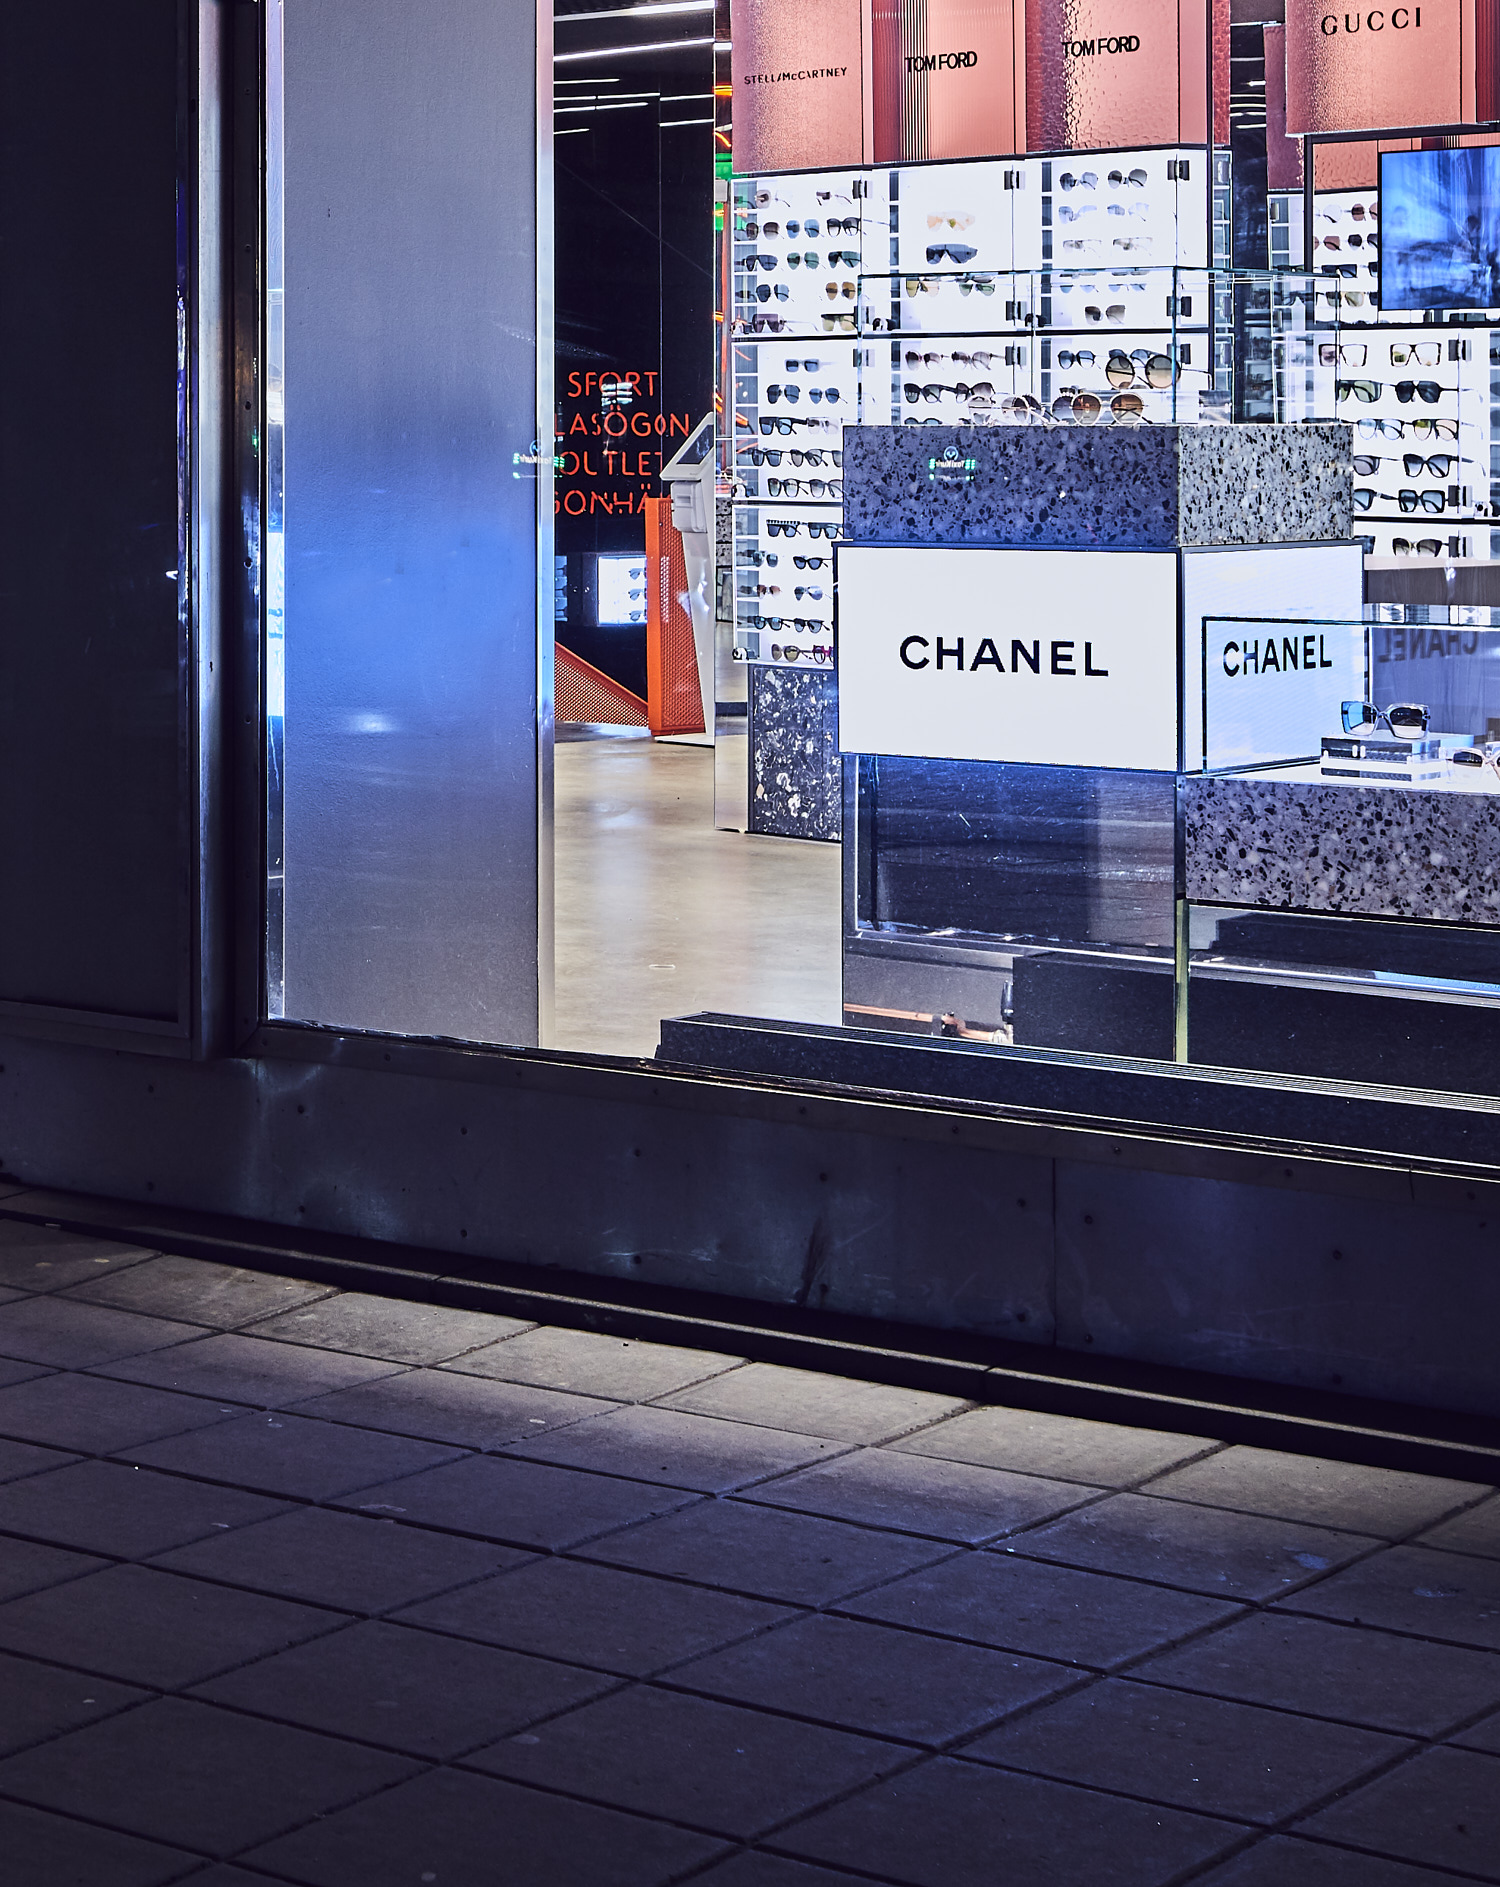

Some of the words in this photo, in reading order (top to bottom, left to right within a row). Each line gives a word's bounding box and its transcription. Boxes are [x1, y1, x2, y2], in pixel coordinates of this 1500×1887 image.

[1321, 6, 1423, 36] GUCCI
[905, 55, 937, 73] TOM
[938, 51, 978, 71] FORD
[1062, 39, 1097, 58] TOM
[1098, 35, 1140, 55] FORD
[554, 404, 690, 437] LASÖGON
[900, 634, 1109, 677] CHANEL
[1222, 633, 1333, 678] CHANEL
